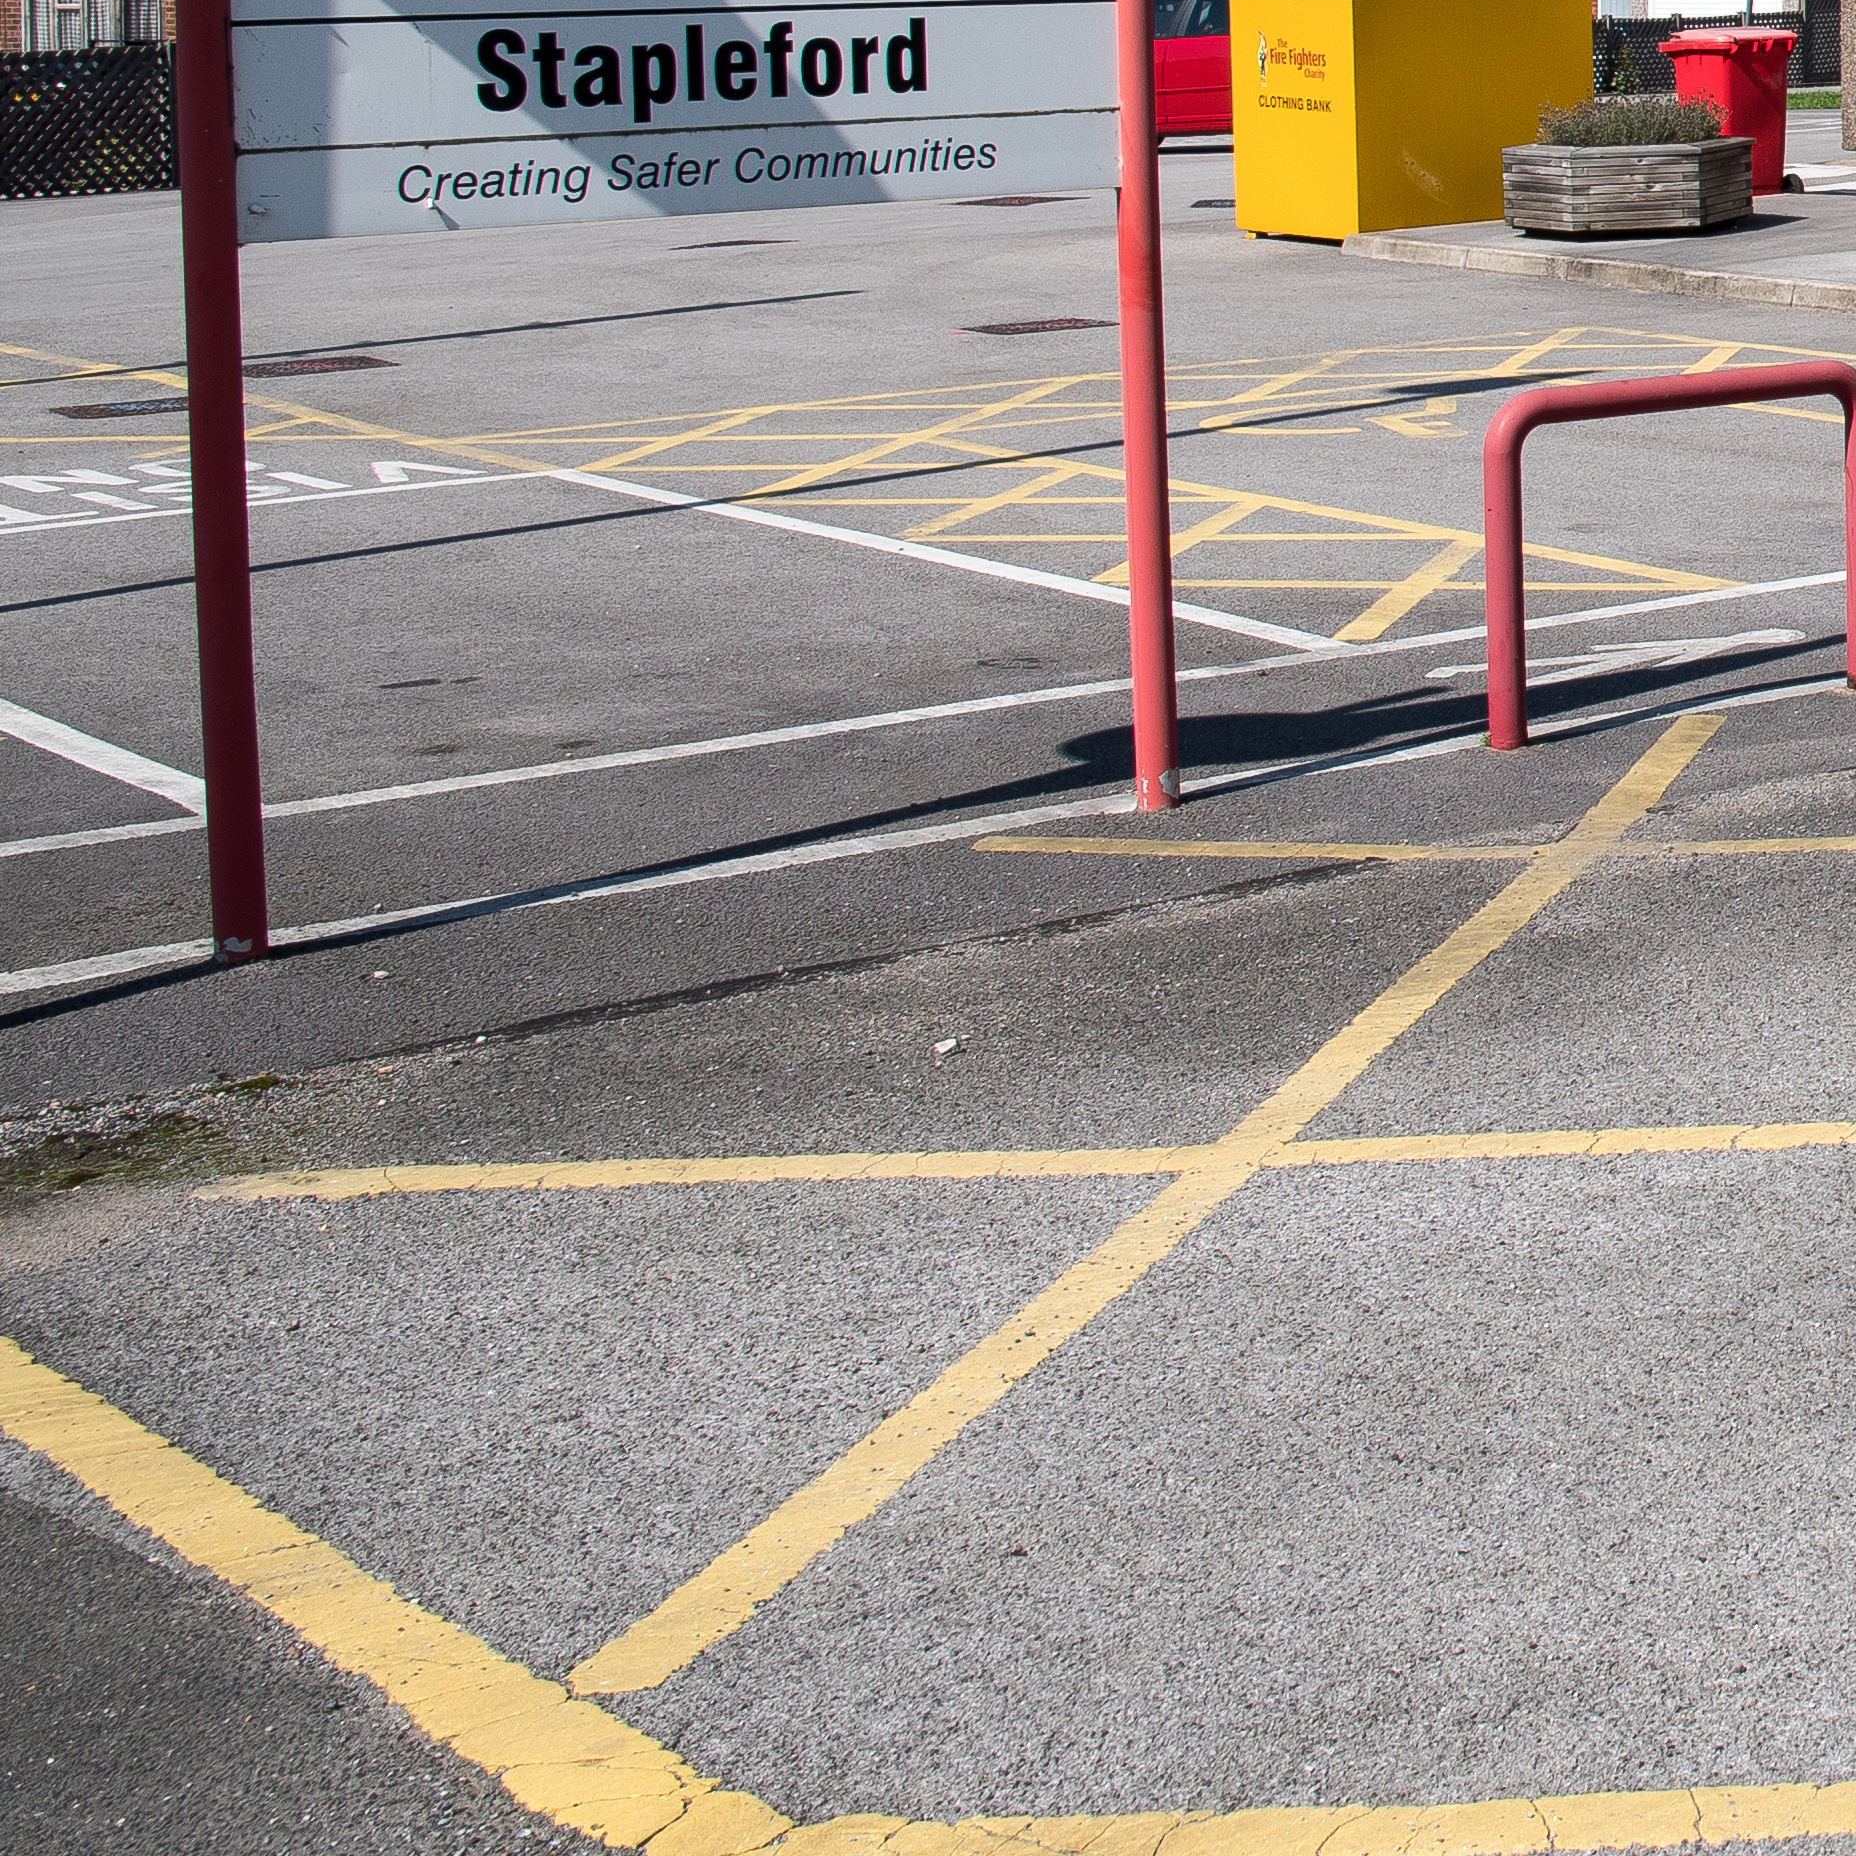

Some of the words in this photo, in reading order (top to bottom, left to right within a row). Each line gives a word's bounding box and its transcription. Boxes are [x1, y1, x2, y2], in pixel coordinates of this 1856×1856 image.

[476, 18, 928, 123] Stapleford
[1270, 47, 1287, 65] Fire
[1289, 48, 1326, 71] Fighters
[1259, 95, 1304, 110] CLOTHING
[1306, 99, 1332, 113] BANK
[398, 162, 592, 204] Creating
[607, 151, 721, 193] Safer
[733, 137, 998, 185] Communities
